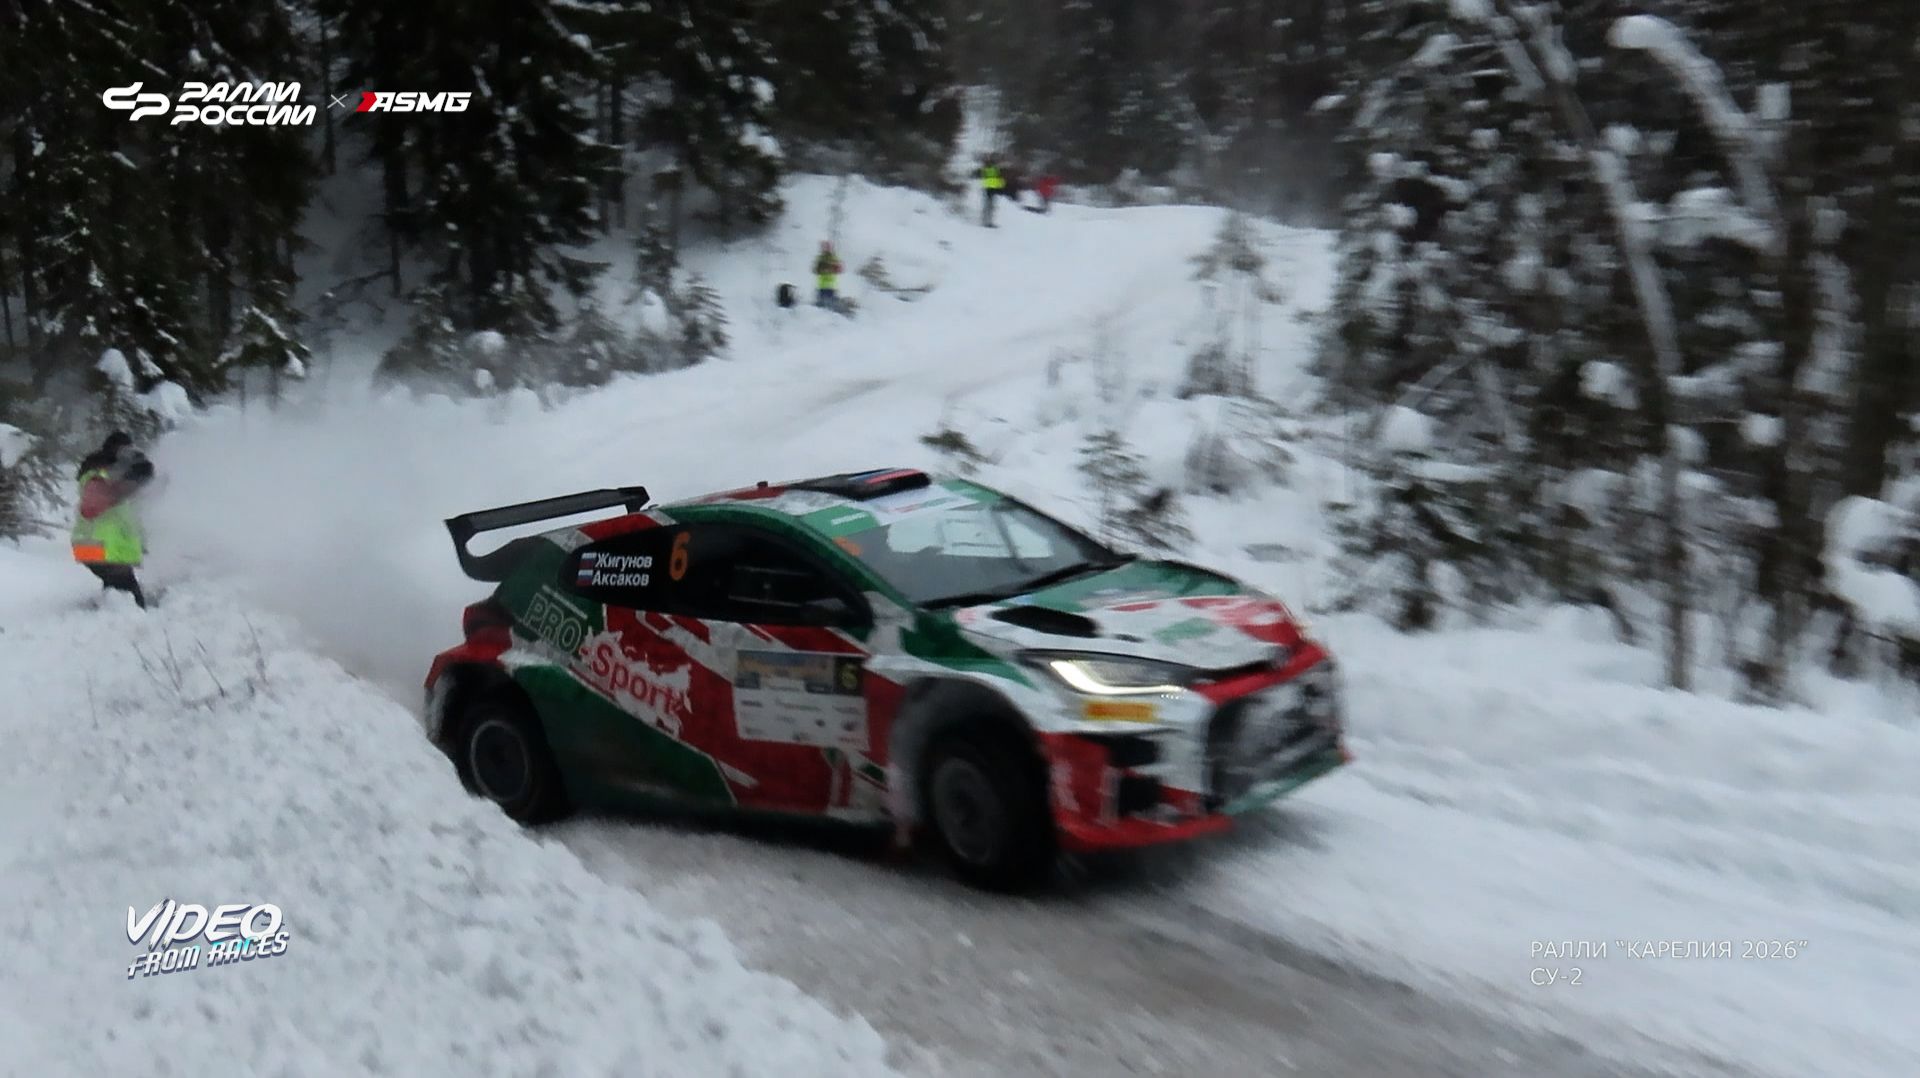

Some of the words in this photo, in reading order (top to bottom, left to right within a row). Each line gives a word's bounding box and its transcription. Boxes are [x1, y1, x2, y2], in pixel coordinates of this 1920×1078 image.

[594, 552, 653, 572] Жигунов
[668, 531, 691, 581] 6
[591, 572, 650, 587] Аксаков
